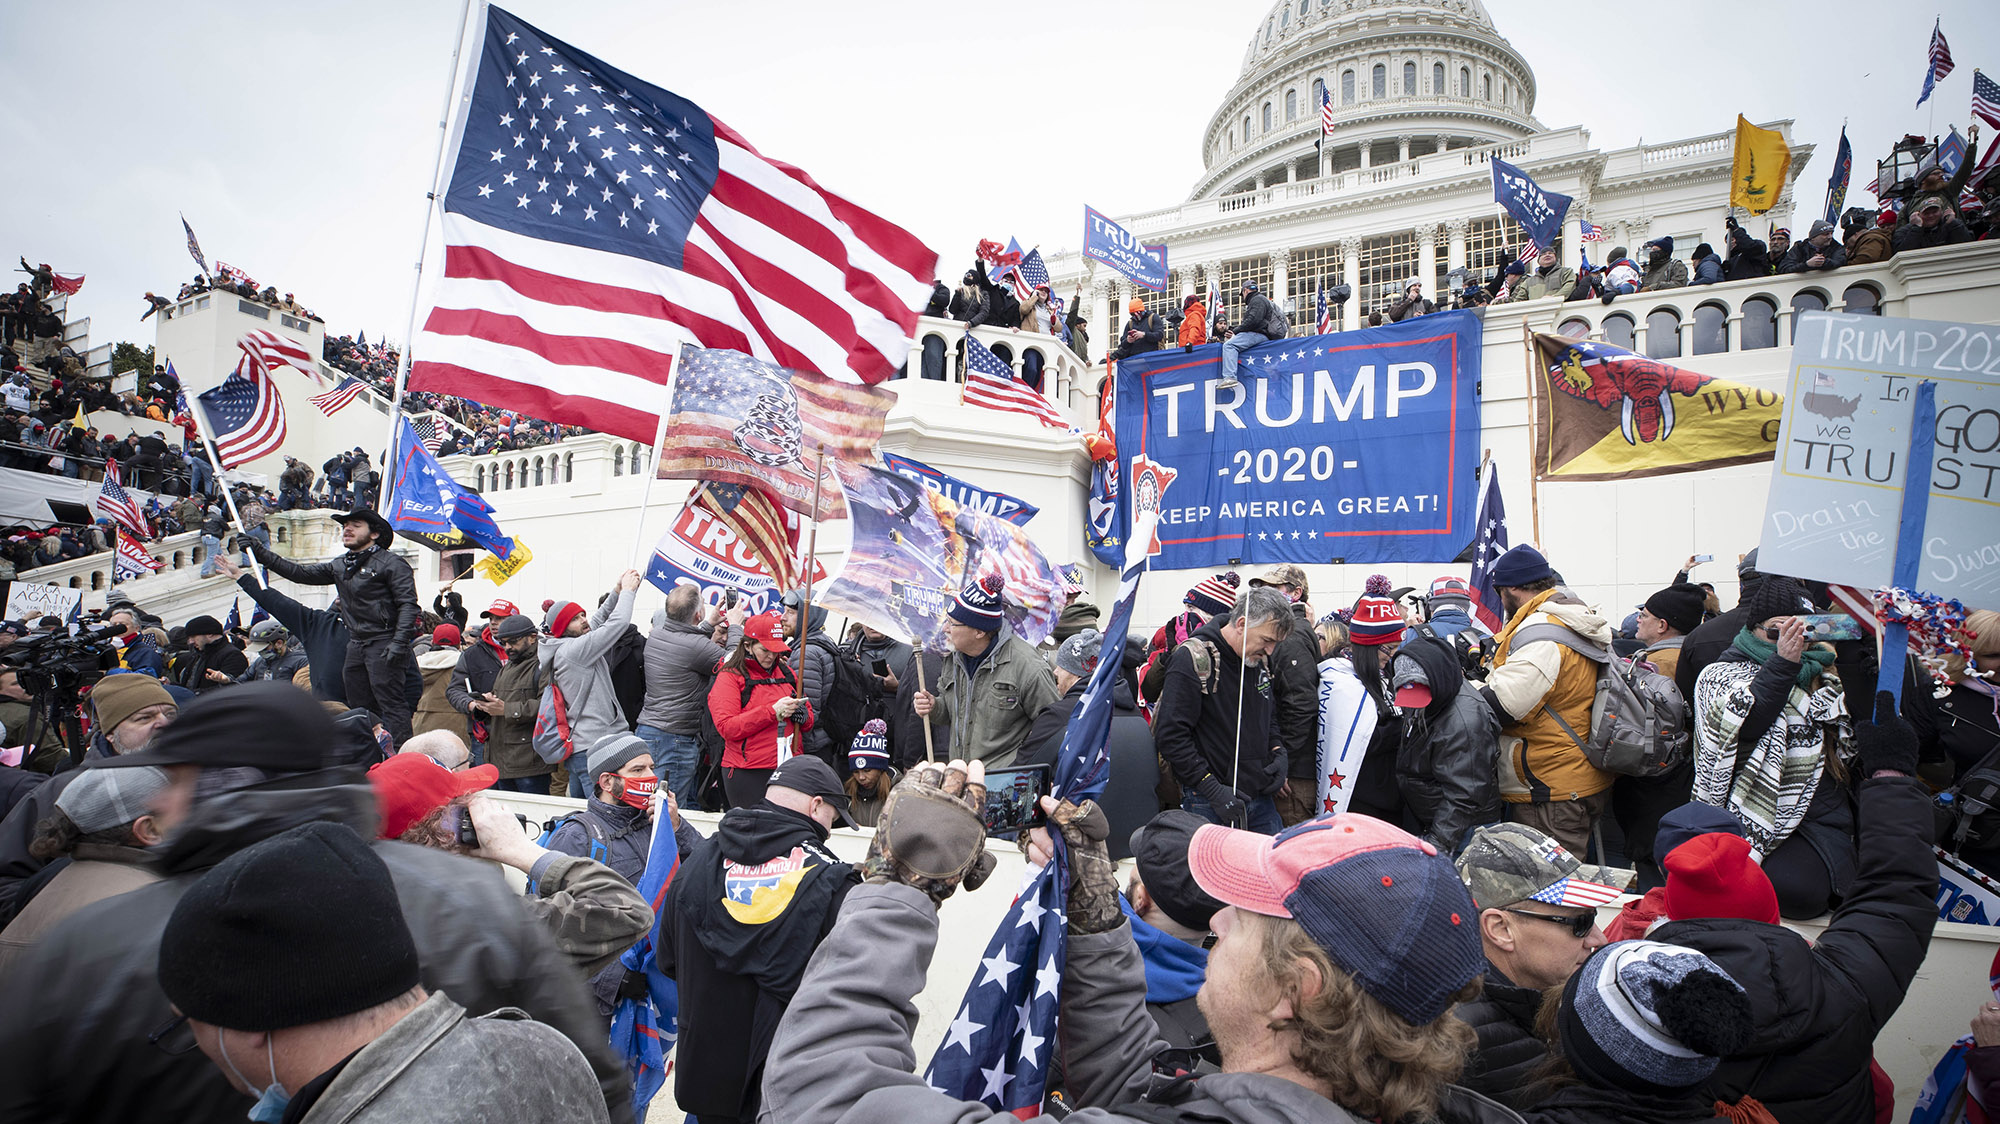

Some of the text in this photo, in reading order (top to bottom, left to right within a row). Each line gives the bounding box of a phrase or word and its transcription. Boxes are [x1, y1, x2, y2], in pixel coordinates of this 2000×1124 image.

[1089, 246, 1109, 259] KEEP
[1136, 272, 1163, 286] GREAT!
[1802, 316, 1938, 367] TRUMP
[1153, 361, 1438, 438] TRUMP
[1879, 375, 1910, 402] In
[1816, 424, 1852, 440] we
[1934, 404, 2000, 454] GO
[786, 480, 812, 501] ON
[1157, 494, 1439, 526] KEEP AMERICA GREAT!
[1772, 500, 1880, 538] Drain
[1839, 531, 1886, 551] the
[692, 556, 709, 572] NO
[711, 566, 742, 582] MORE
[15, 590, 71, 606] AGAIN
[26, 583, 61, 595] MAGA
[1365, 604, 1401, 619] TRU
[851, 736, 888, 751] RUMP
[639, 782, 658, 792] TRU
